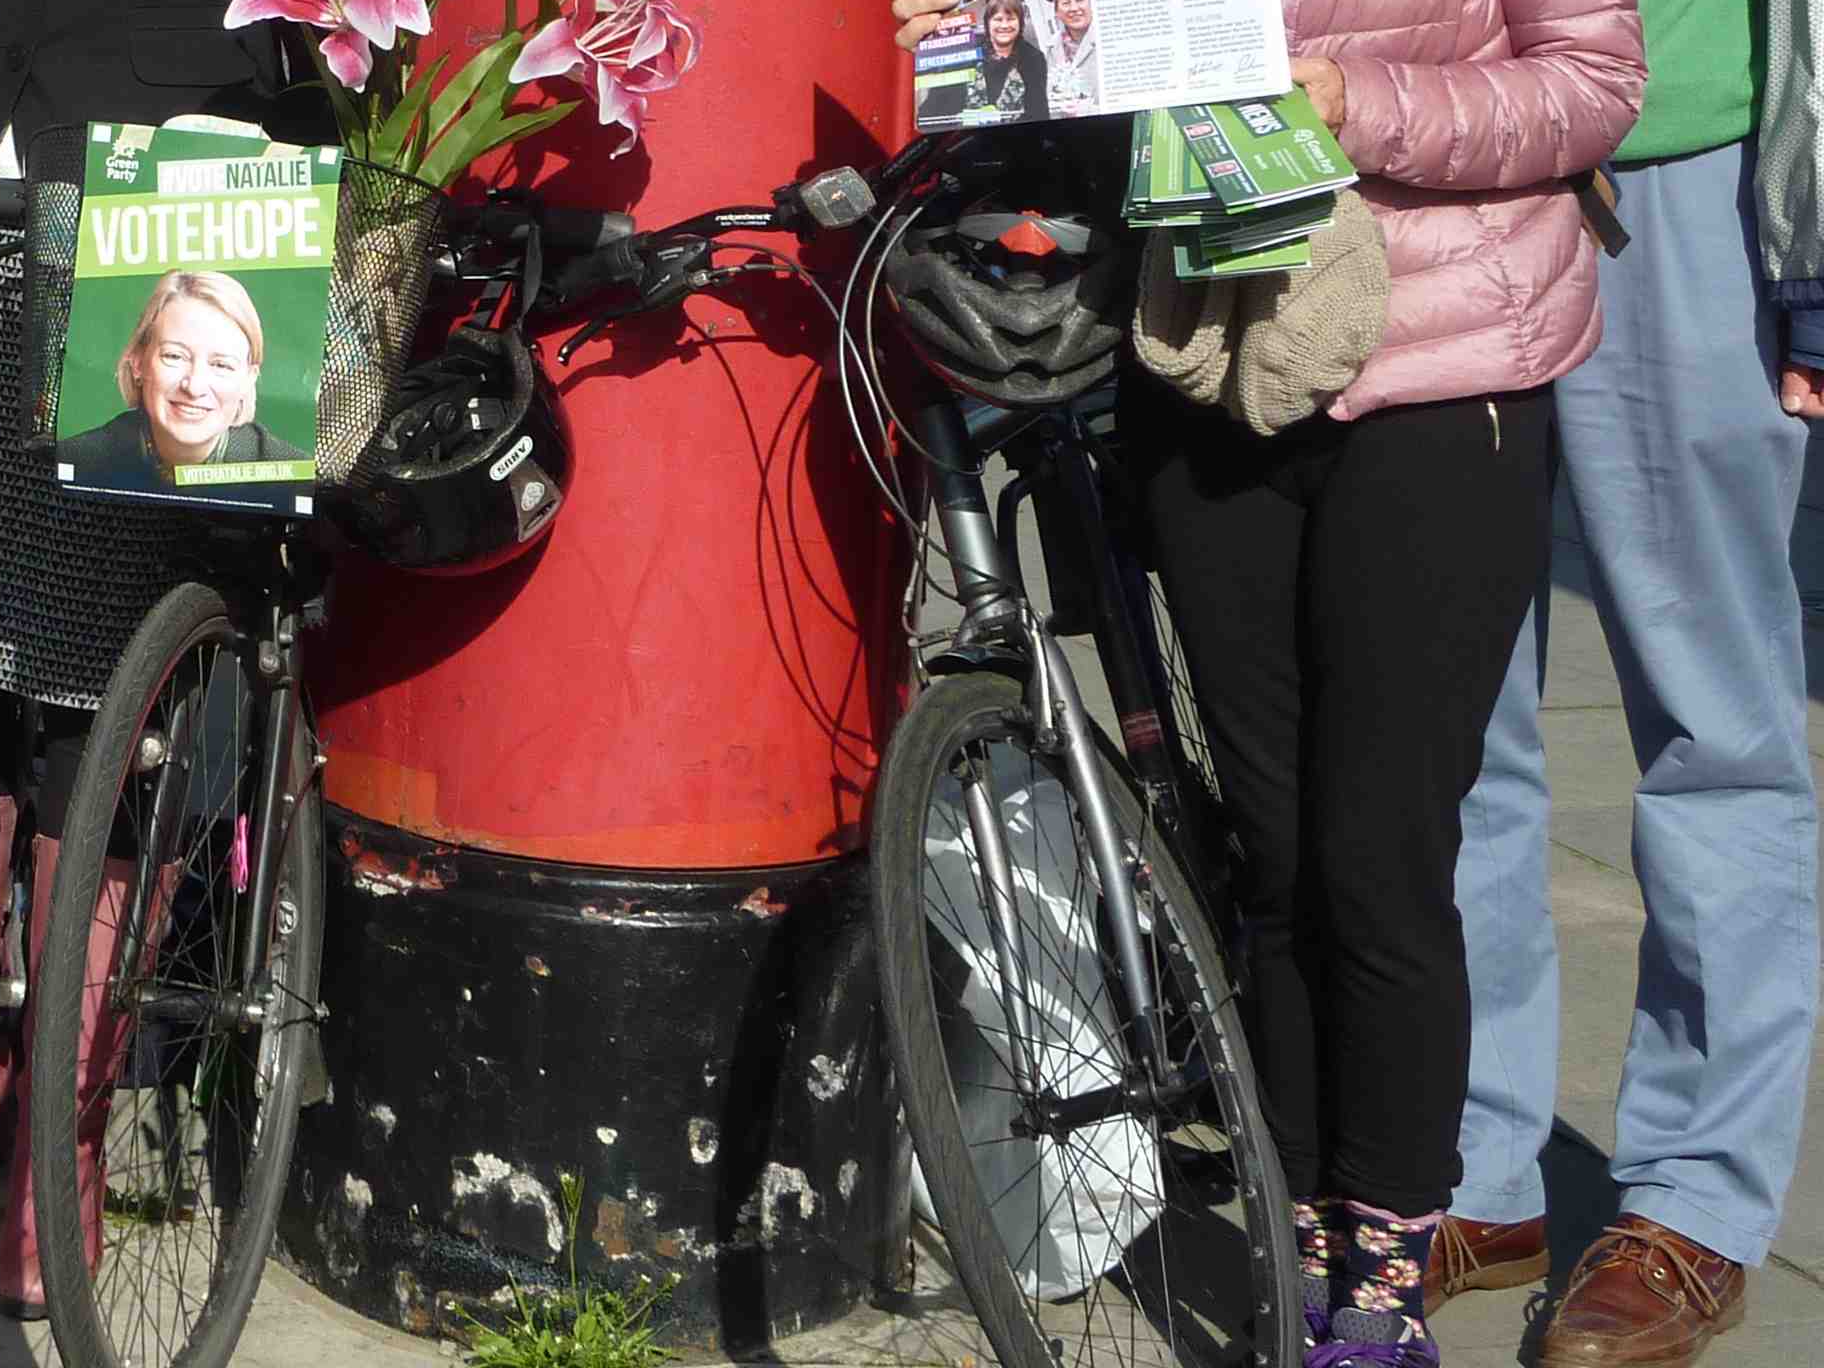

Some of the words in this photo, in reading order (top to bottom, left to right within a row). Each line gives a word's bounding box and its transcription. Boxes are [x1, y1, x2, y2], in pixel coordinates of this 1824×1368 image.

[105, 156, 139, 171] Green
[106, 167, 138, 184] Party
[91, 197, 322, 266] VOTEHOPE
